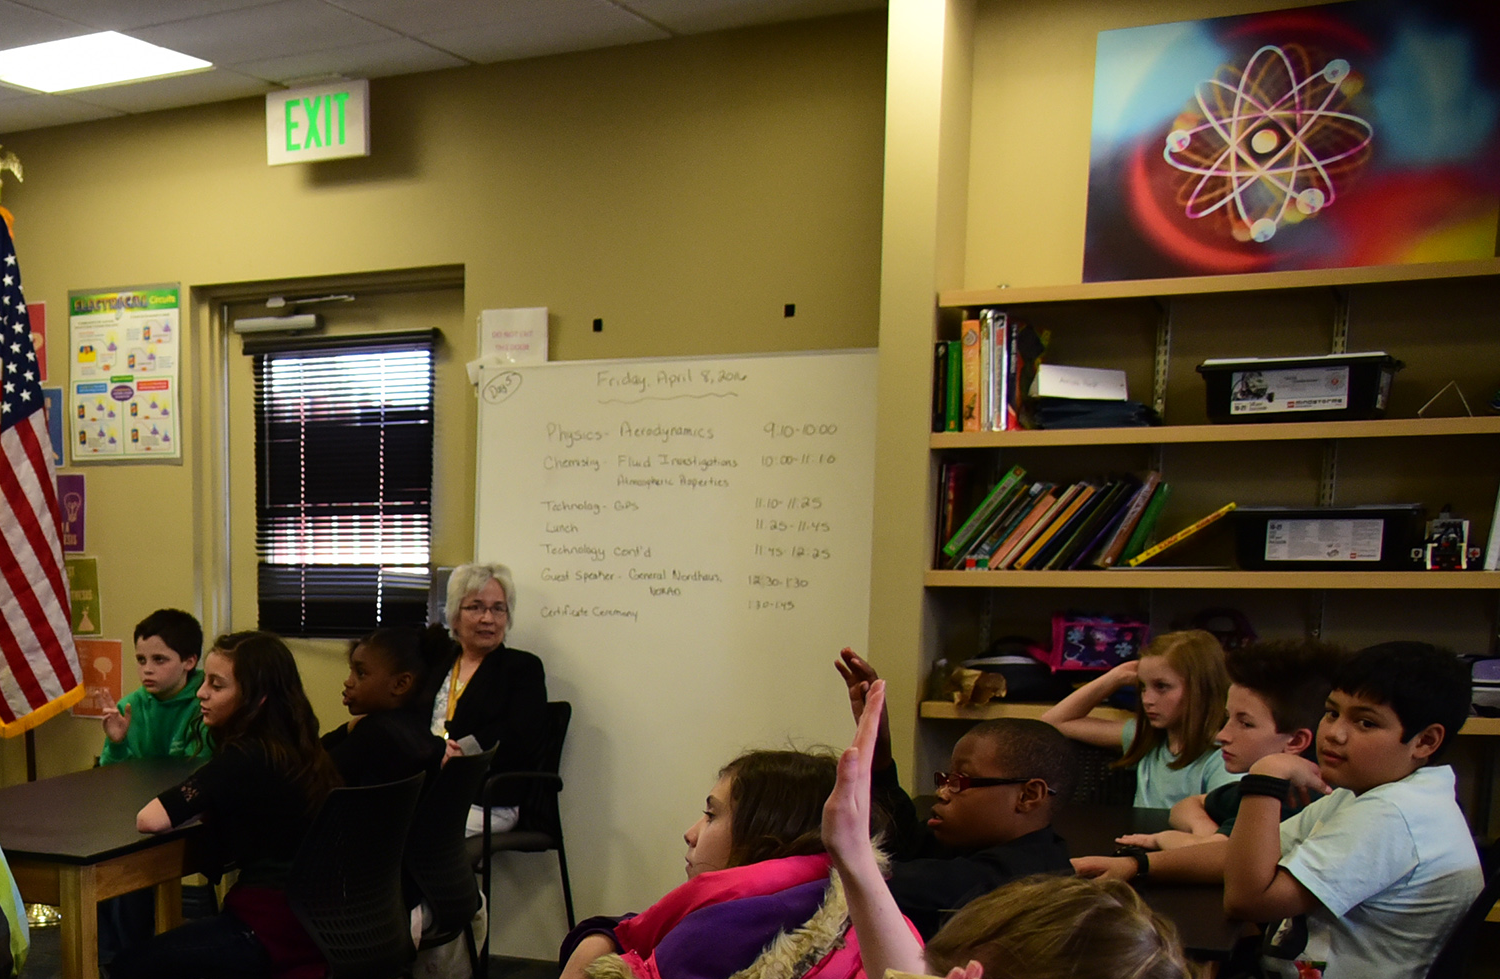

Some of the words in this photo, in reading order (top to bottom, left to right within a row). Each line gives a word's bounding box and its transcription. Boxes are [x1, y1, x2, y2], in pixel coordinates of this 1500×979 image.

[285, 92, 349, 151] EXIT
[597, 369, 650, 393] Friday,
[657, 369, 692, 388] April
[489, 384, 507, 400] Day
[620, 421, 714, 443] Aerodynamics
[617, 454, 651, 468] Fluid
[614, 500, 640, 511] GPS
[545, 522, 579, 533] Lunch
[540, 543, 605, 562] Technology
[541, 568, 569, 582] Guest
[628, 568, 667, 581] General
[540, 605, 588, 618] Certificate
[592, 607, 638, 622] Ceremony
